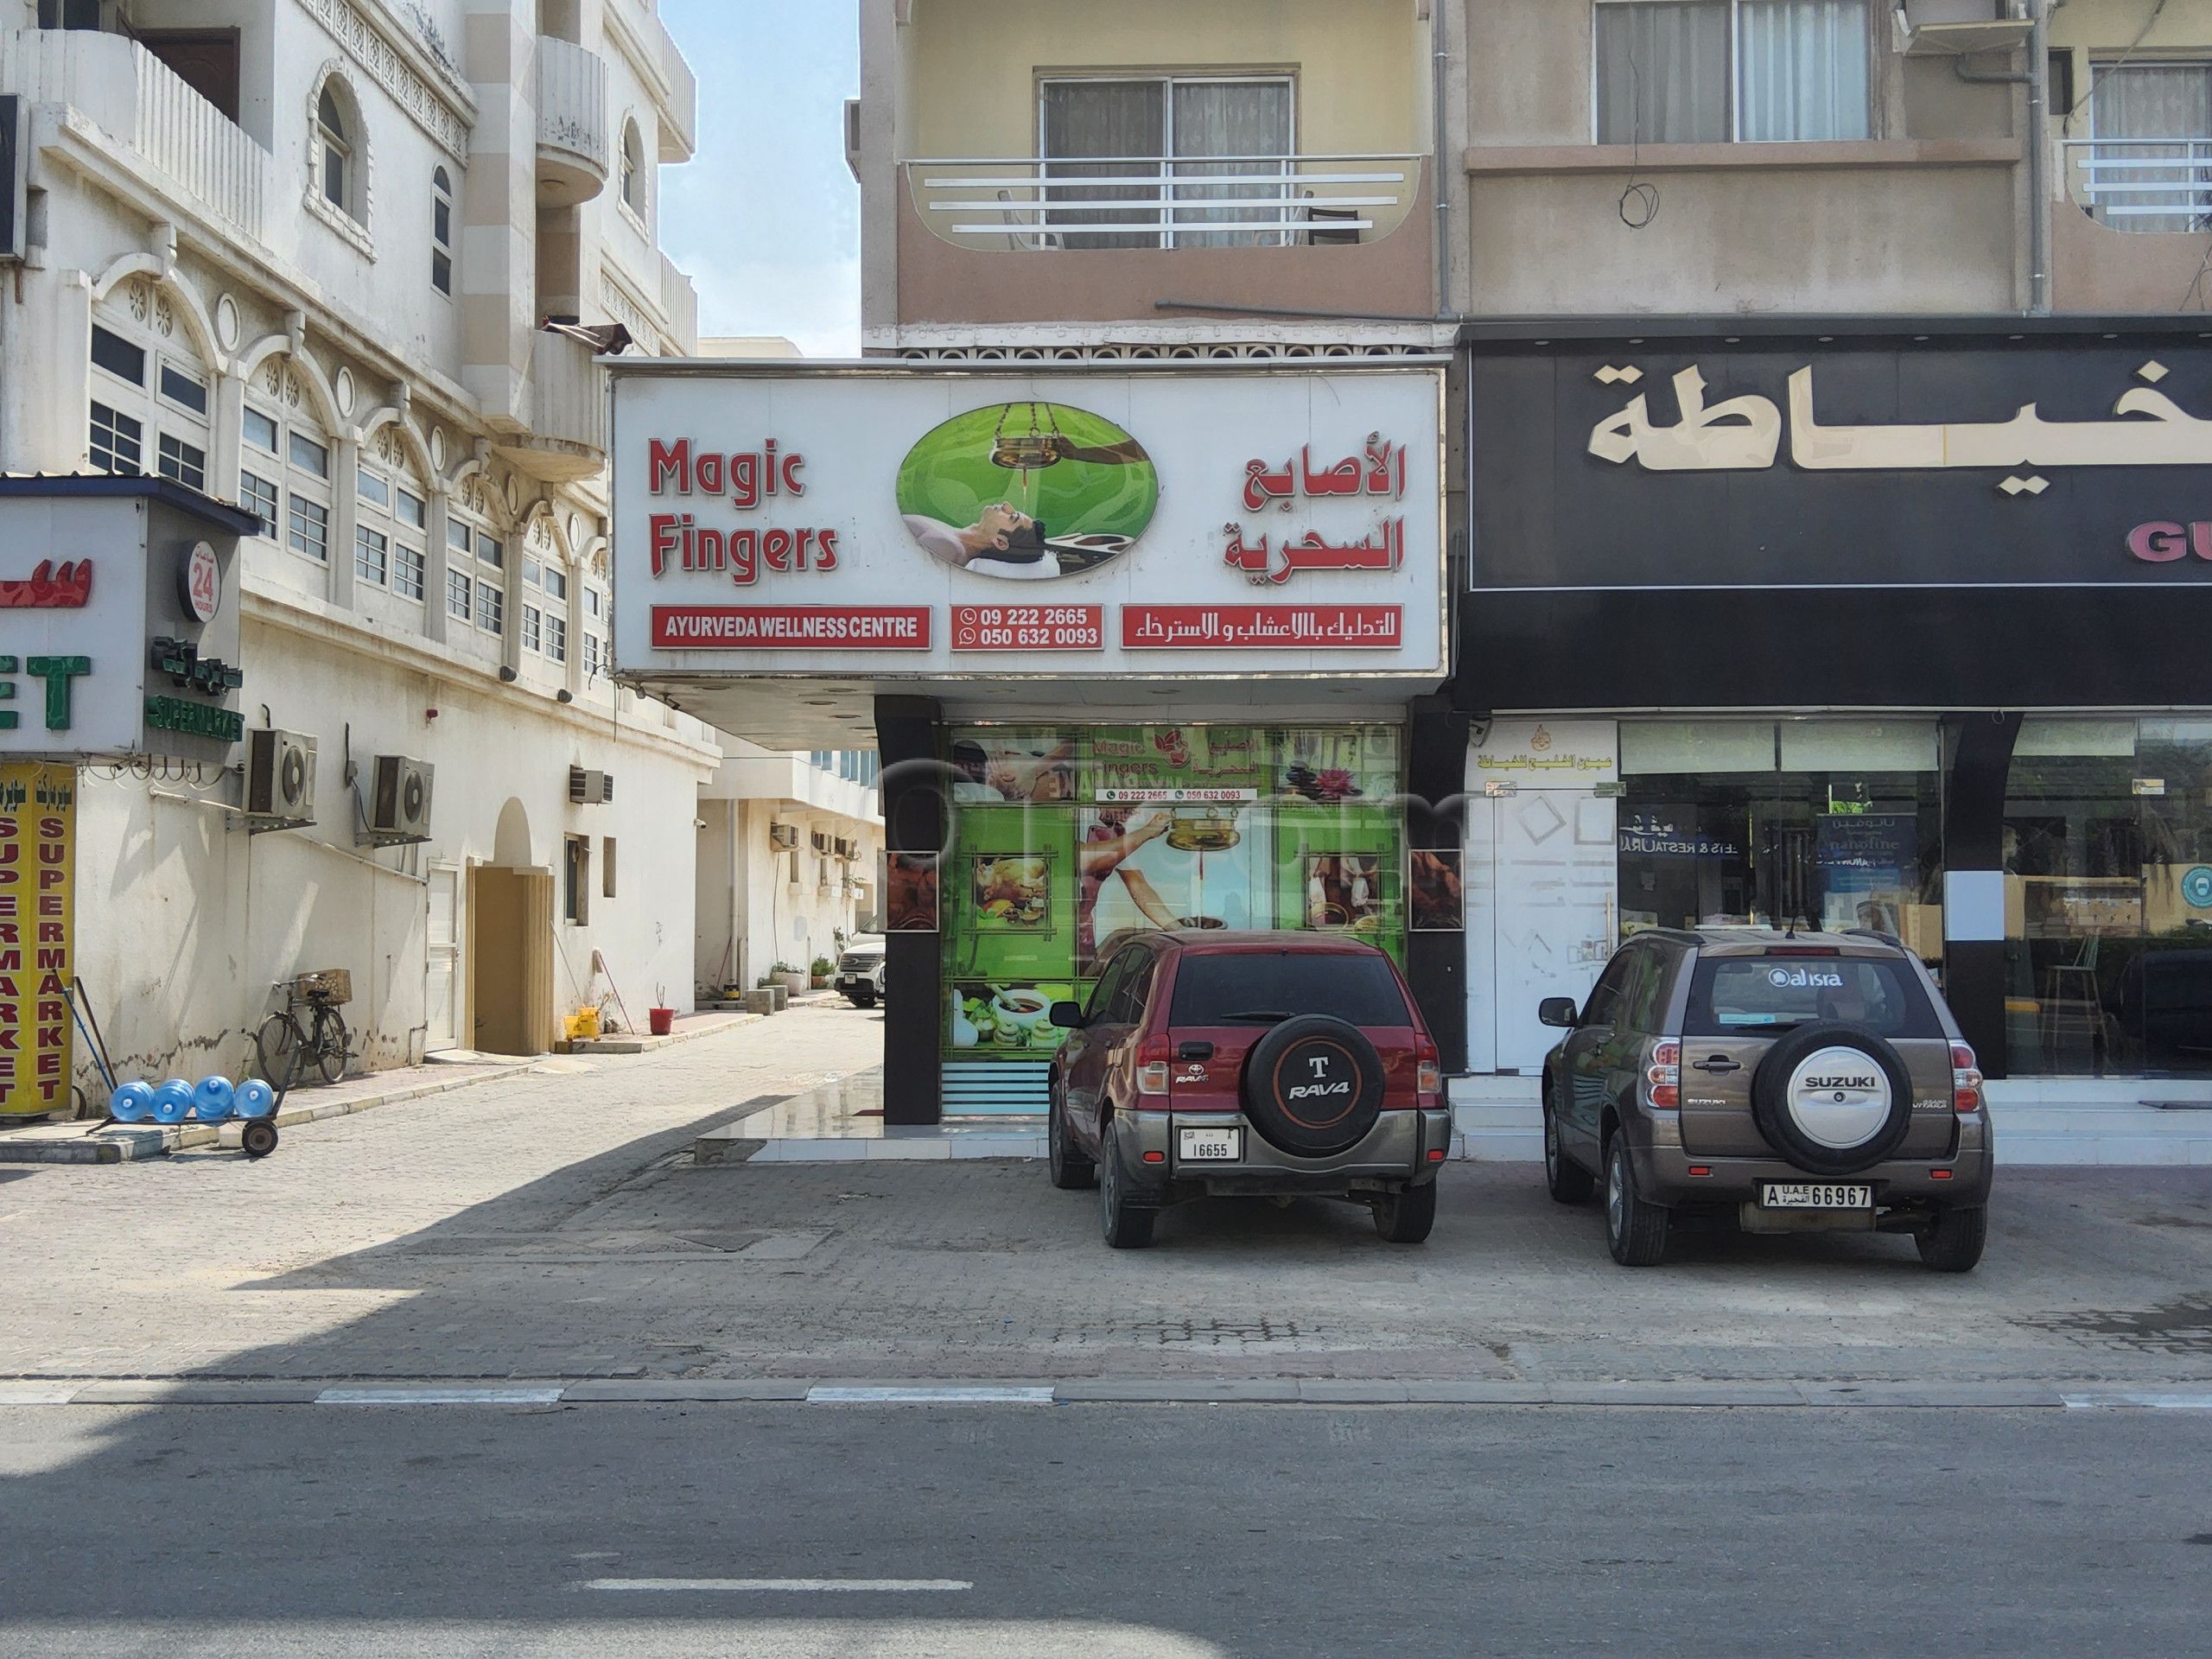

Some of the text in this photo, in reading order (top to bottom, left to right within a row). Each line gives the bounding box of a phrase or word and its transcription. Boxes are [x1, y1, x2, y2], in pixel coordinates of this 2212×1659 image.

[649, 438, 805, 510] Magic
[1243, 430, 1407, 512] الأصابع
[649, 513, 838, 586] Fingers
[1224, 515, 1405, 585] السحرية
[193, 563, 214, 601] 24
[194, 602, 213, 614] HOURS
[980, 608, 1088, 626] 09 222 2665
[665, 616, 918, 639] AYURVEDA WELLNESS CENTRE
[980, 628, 1098, 645] 050 632 0093
[1326, 612, 1395, 641] للتدليك
[1092, 740, 1146, 757] Magic
[1092, 760, 1160, 778] Fingers
[1118, 790, 1241, 800] 09 222 2665 050 632 0093
[37, 817, 66, 1101] SUPERMARKET
[1308, 1057, 1329, 1078] T
[1288, 1081, 1350, 1100] RAV4
[1805, 1077, 1875, 1088] SUZUKI
[1193, 1143, 1228, 1157] 16655
[1767, 1185, 1869, 1206] A U.A.E 66967
